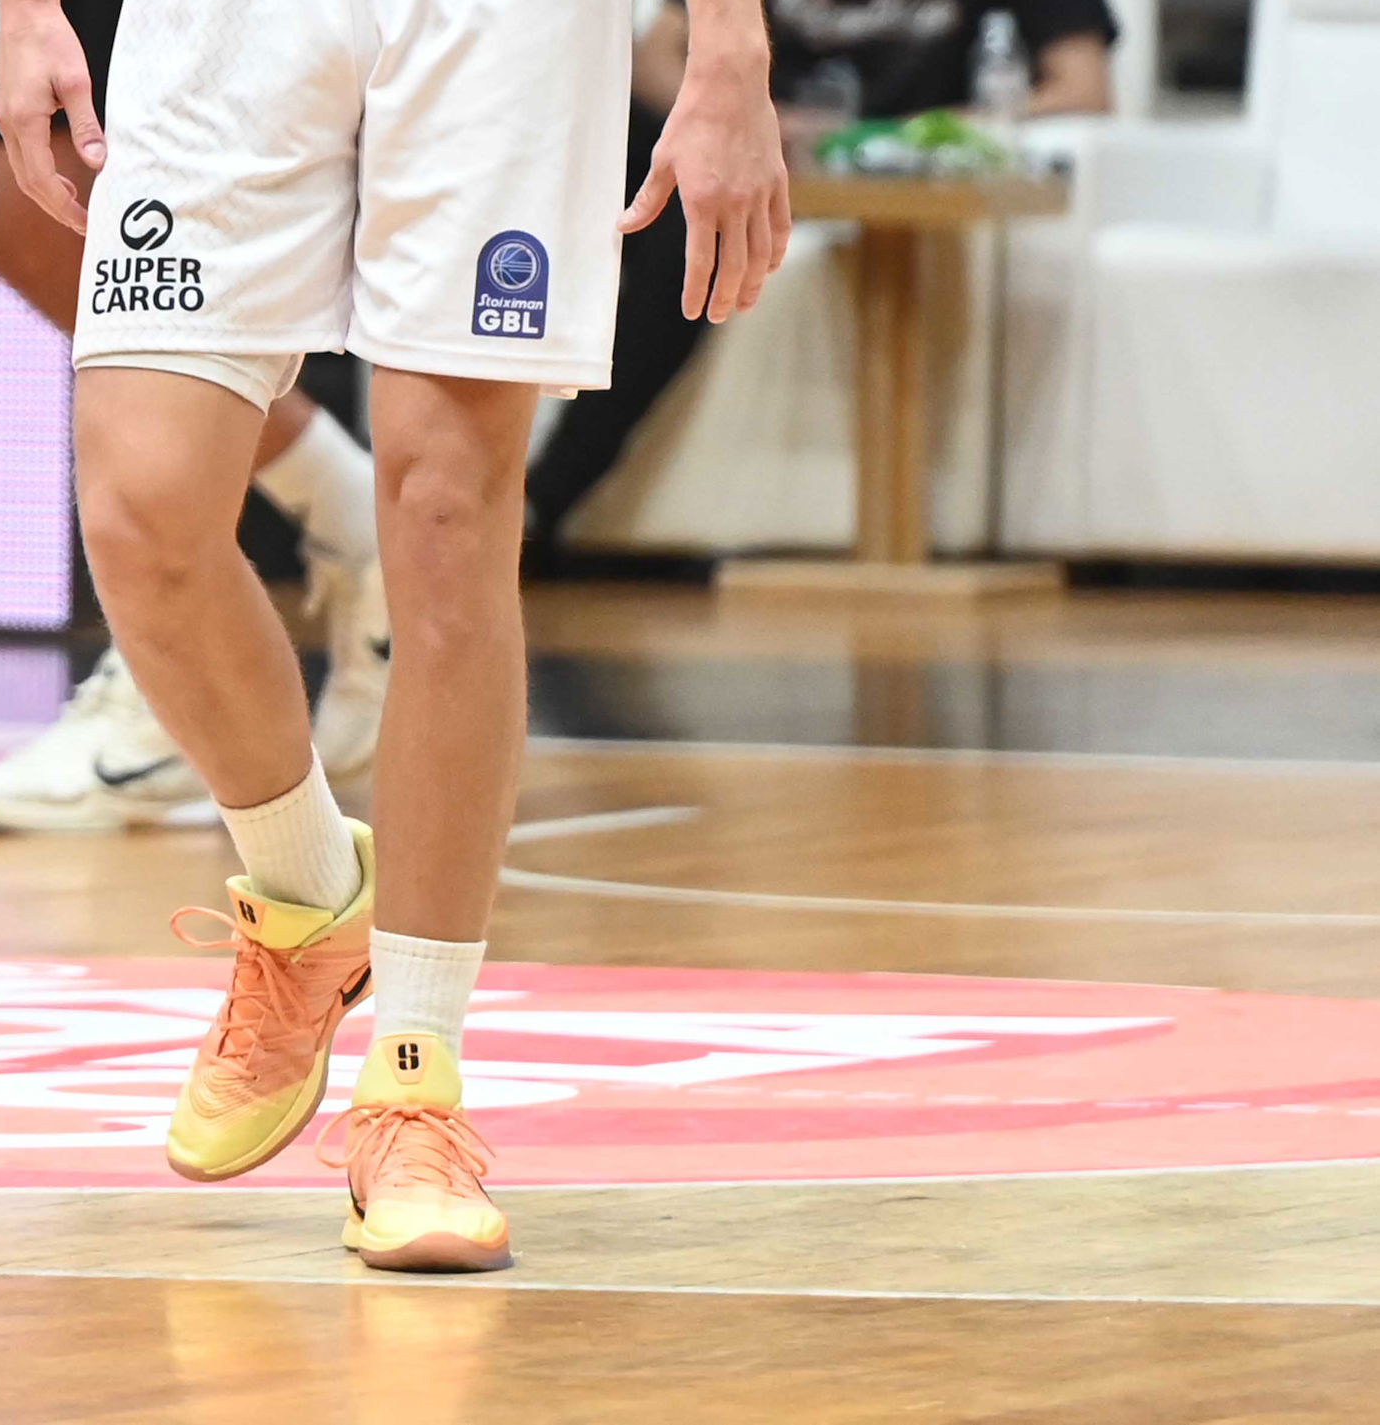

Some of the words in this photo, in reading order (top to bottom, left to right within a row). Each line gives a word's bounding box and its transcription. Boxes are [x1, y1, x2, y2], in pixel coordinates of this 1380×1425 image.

[95, 257, 201, 286] SUPER
[92, 285, 204, 314] CARGO
[477, 293, 544, 310] Stoiximan
[478, 309, 539, 334] GBL
